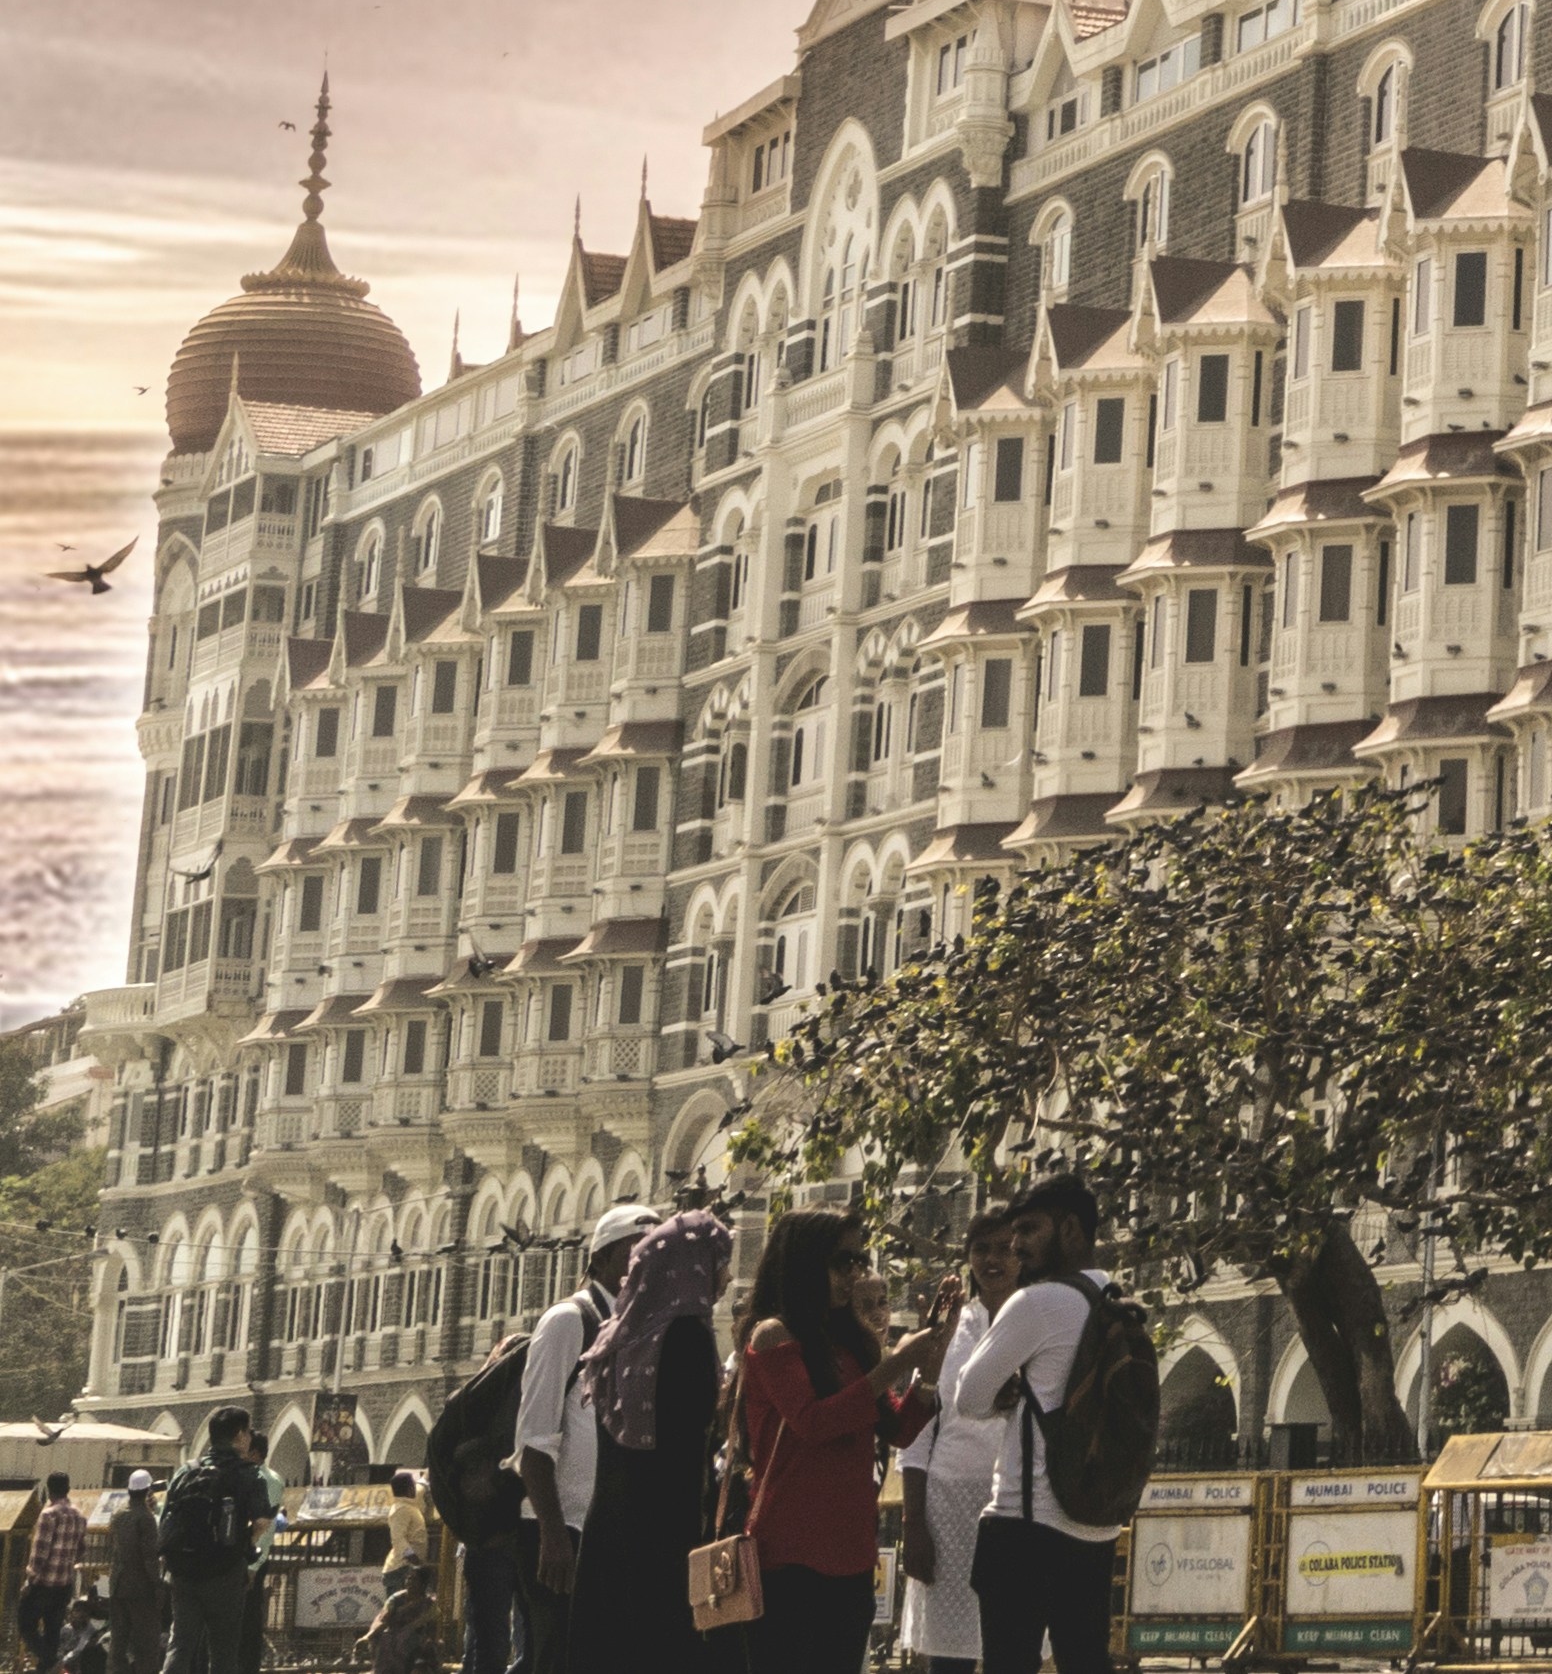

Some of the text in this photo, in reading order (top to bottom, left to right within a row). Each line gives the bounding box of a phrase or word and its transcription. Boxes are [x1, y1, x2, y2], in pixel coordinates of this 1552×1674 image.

[1150, 1486, 1240, 1500] MUMBAI POLICE
[1305, 1482, 1407, 1497] MUMBAI POLICE
[1309, 1557, 1339, 1572] COLABA
[1340, 1555, 1367, 1570] POLICE
[1164, 1630, 1200, 1642] MUMBAI
[1205, 1630, 1232, 1642] CLEAN
[1297, 1629, 1400, 1642] KEEP MUMBAI CLEAN
